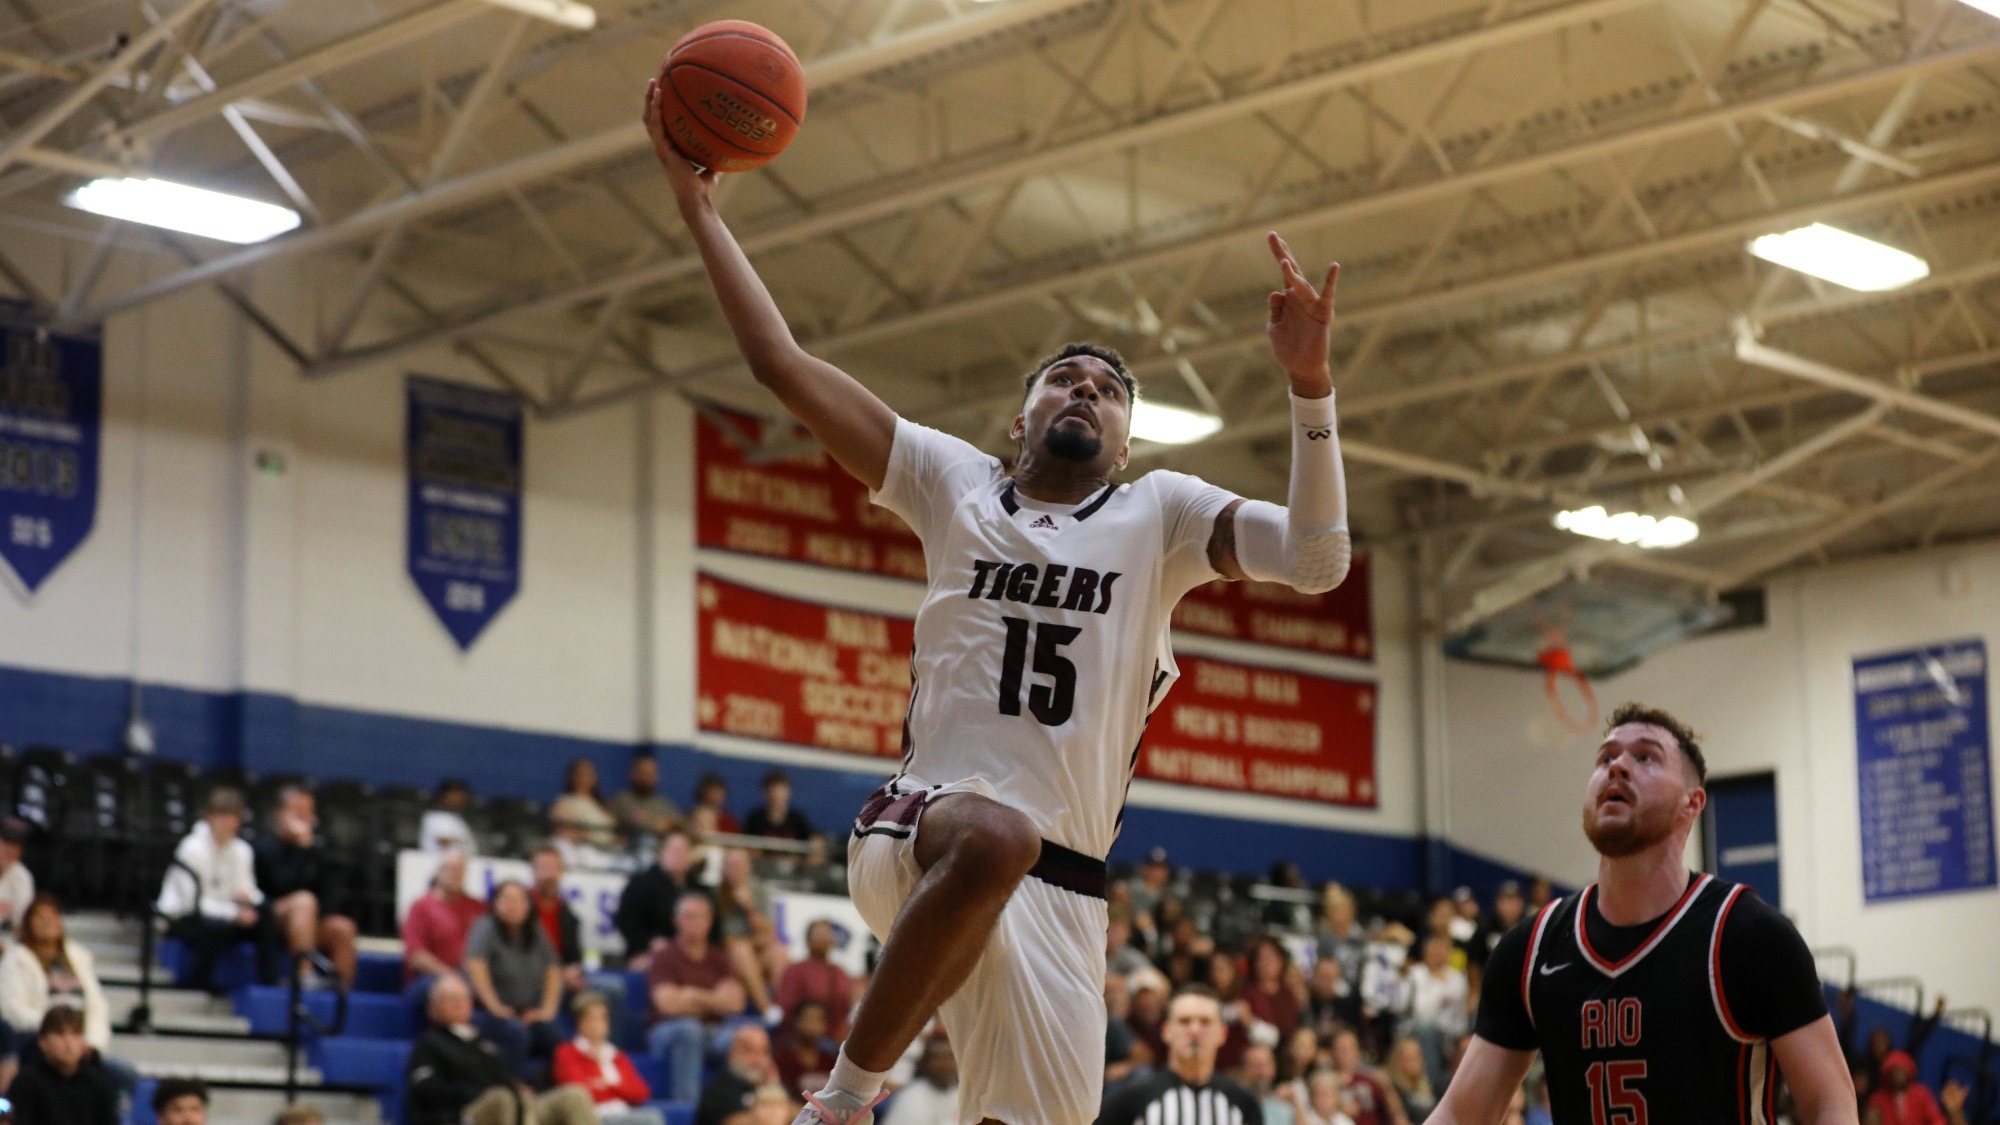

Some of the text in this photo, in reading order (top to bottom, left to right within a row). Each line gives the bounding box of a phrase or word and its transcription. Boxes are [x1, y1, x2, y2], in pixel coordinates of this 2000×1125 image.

[700, 98, 776, 147] LEGACY
[1029, 522, 1059, 531] adidas
[968, 559, 1122, 615] TIGERS
[712, 617, 845, 681] NATIONAL
[998, 616, 1083, 727] 15
[1147, 745, 1350, 800] NATIONAL CHAMPION
[1582, 997, 1642, 1049] RIO
[1585, 1059, 1649, 1125] 15
